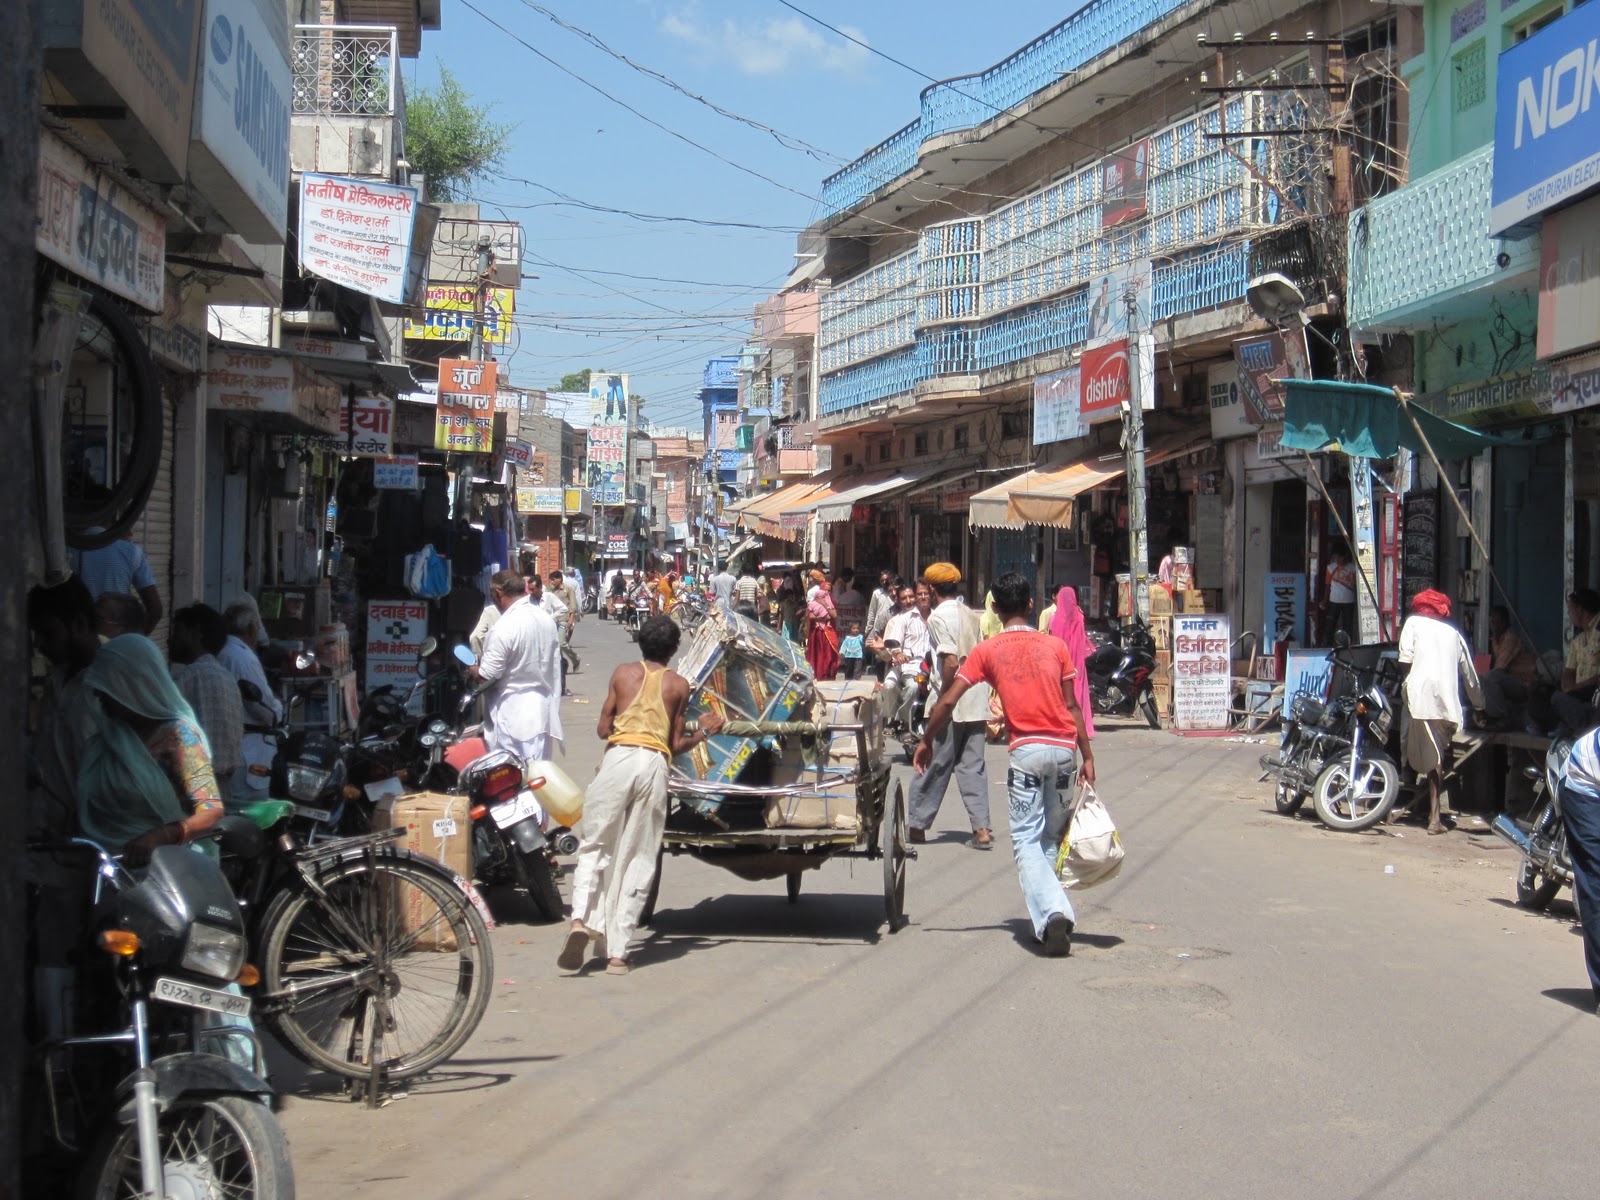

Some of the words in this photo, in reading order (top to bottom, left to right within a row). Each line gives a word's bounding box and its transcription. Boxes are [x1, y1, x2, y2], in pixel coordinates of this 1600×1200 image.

[235, 24, 288, 195] SAMSUNG
[305, 180, 347, 202] मनीष
[1526, 187, 1546, 210] SHRI
[1545, 174, 1572, 202] PURAN
[1574, 157, 1600, 187] ELECT
[336, 209, 364, 225] दिनेश
[363, 216, 390, 228] शर्मा
[330, 236, 365, 253] रजनीश
[364, 245, 391, 257] शर्मा
[1086, 374, 1121, 404] dishtv
[442, 393, 492, 411] चप्पल
[440, 415, 453, 427] का
[355, 438, 388, 454] स्टोर
[447, 433, 473, 446] अन्दर
[506, 446, 531, 462] टाखे
[608, 540, 629, 550] cozi
[370, 602, 427, 622] दवाईयां
[1181, 620, 1218, 631] भारत
[1176, 634, 1228, 654] डिजीटल
